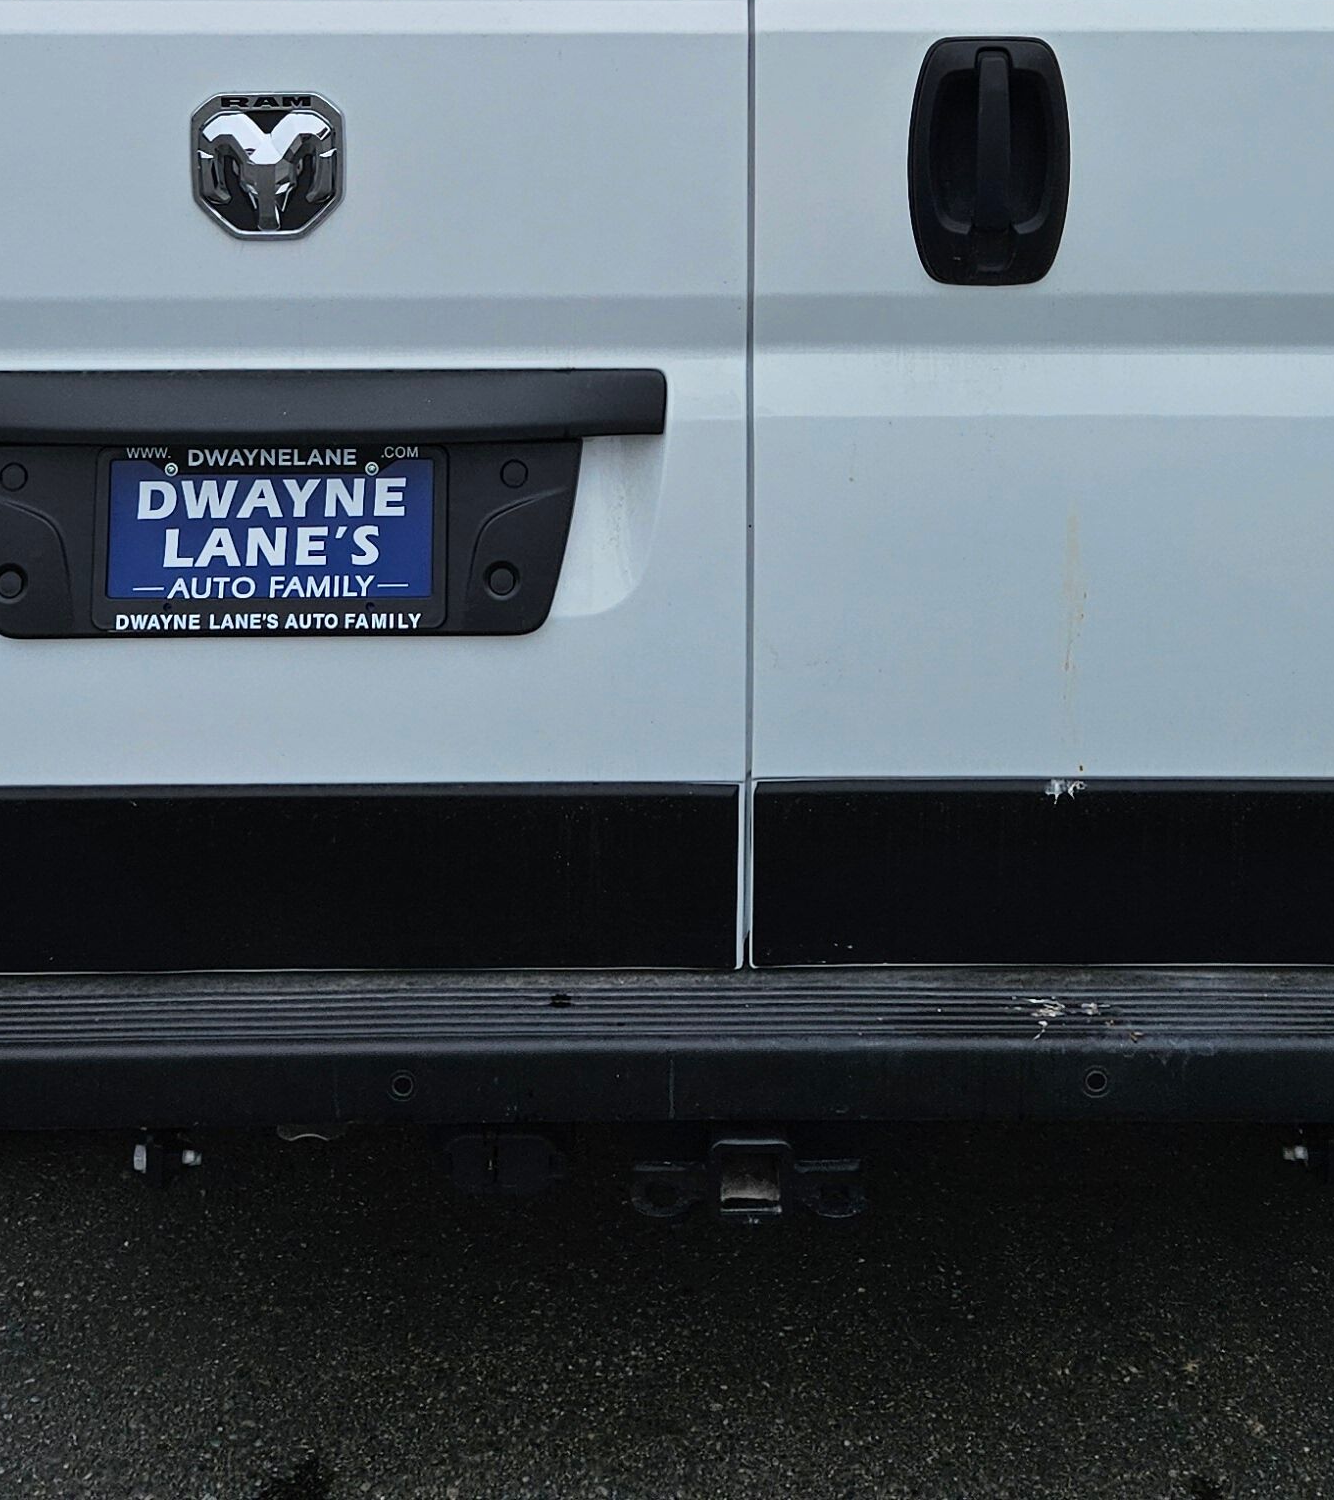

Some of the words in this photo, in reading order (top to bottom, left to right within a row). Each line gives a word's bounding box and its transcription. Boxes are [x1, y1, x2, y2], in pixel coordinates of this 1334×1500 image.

[220, 95, 312, 108] RAM
[187, 448, 357, 467] DWAYNELANE
[380, 446, 419, 459] .COM
[137, 476, 407, 521] DWAYNE
[163, 525, 381, 568] LANE'S
[167, 576, 256, 599] AUTO
[269, 575, 375, 598] FAMILY
[115, 613, 201, 630] DWAYNE
[209, 613, 279, 630] LANE'S
[284, 613, 339, 629] AUTO
[344, 612, 422, 629] FAMILY
